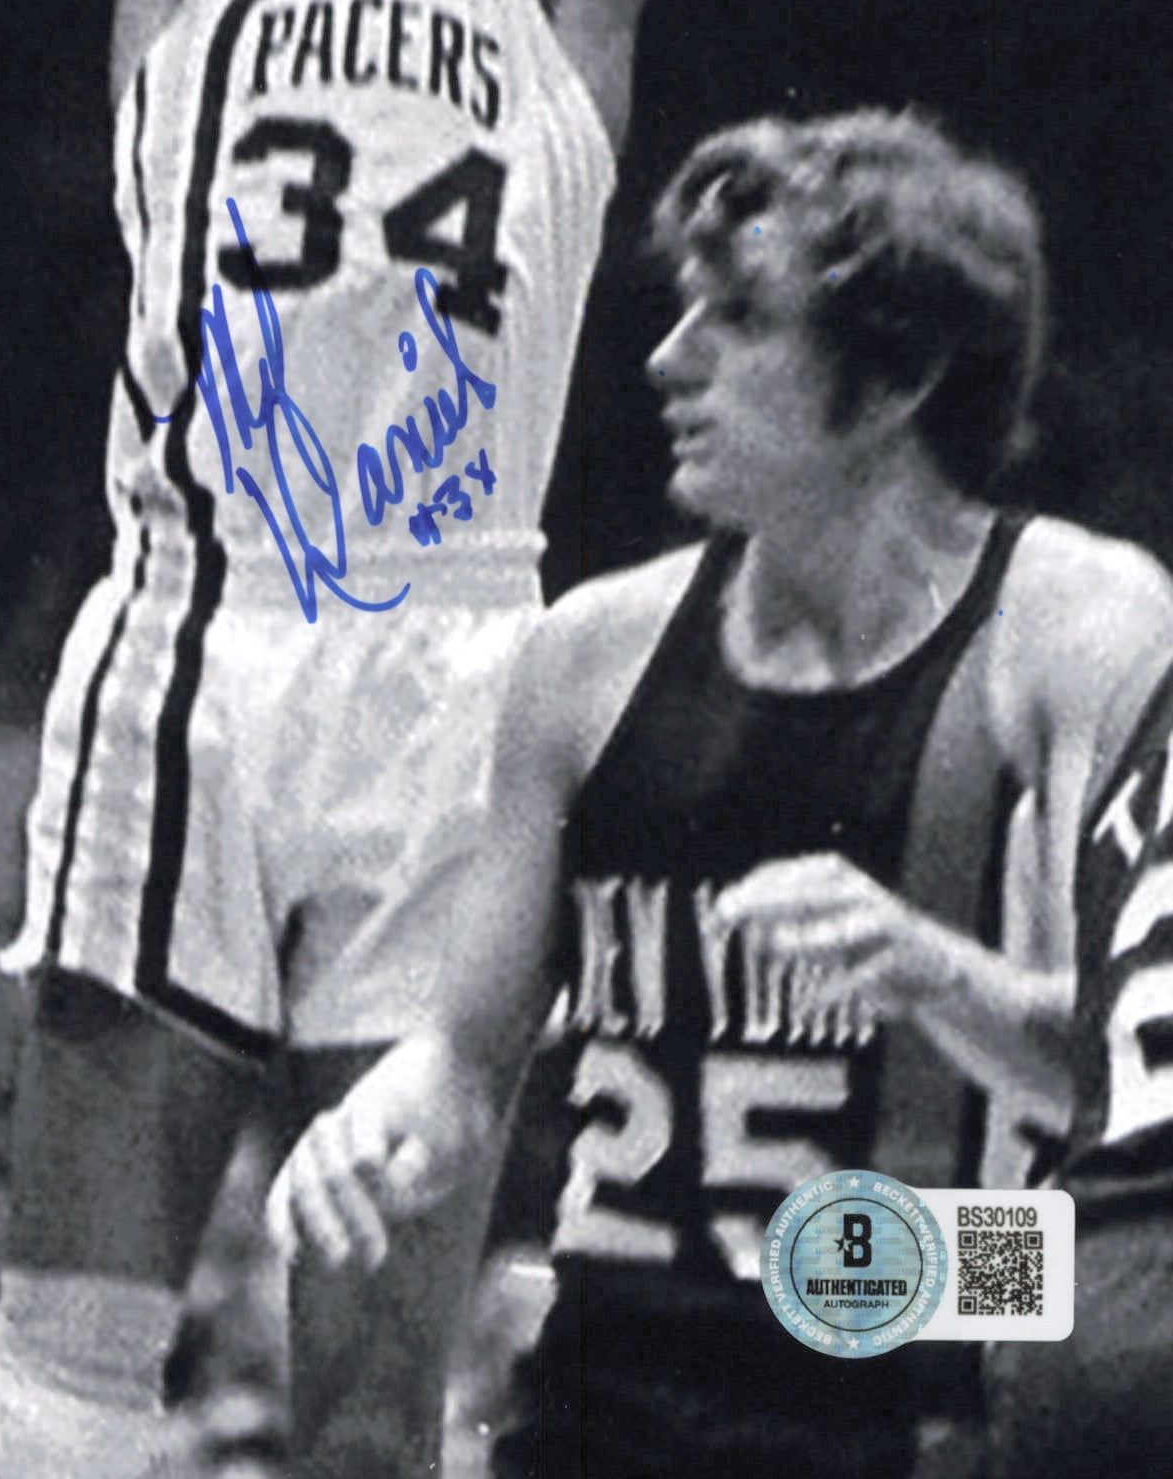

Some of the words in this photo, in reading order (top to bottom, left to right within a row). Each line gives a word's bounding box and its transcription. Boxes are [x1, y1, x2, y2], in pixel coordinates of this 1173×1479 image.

[217, 115, 509, 336] 34
[551, 1042, 849, 1282] 25
[776, 1179, 834, 1239] AUTHENTIC
[872, 1180, 924, 1225] BECKETT
[957, 1206, 1038, 1227] BS30109
[806, 1278, 908, 1297] AUTHENTICATED
[823, 1299, 890, 1310] AUTOGRAPH
